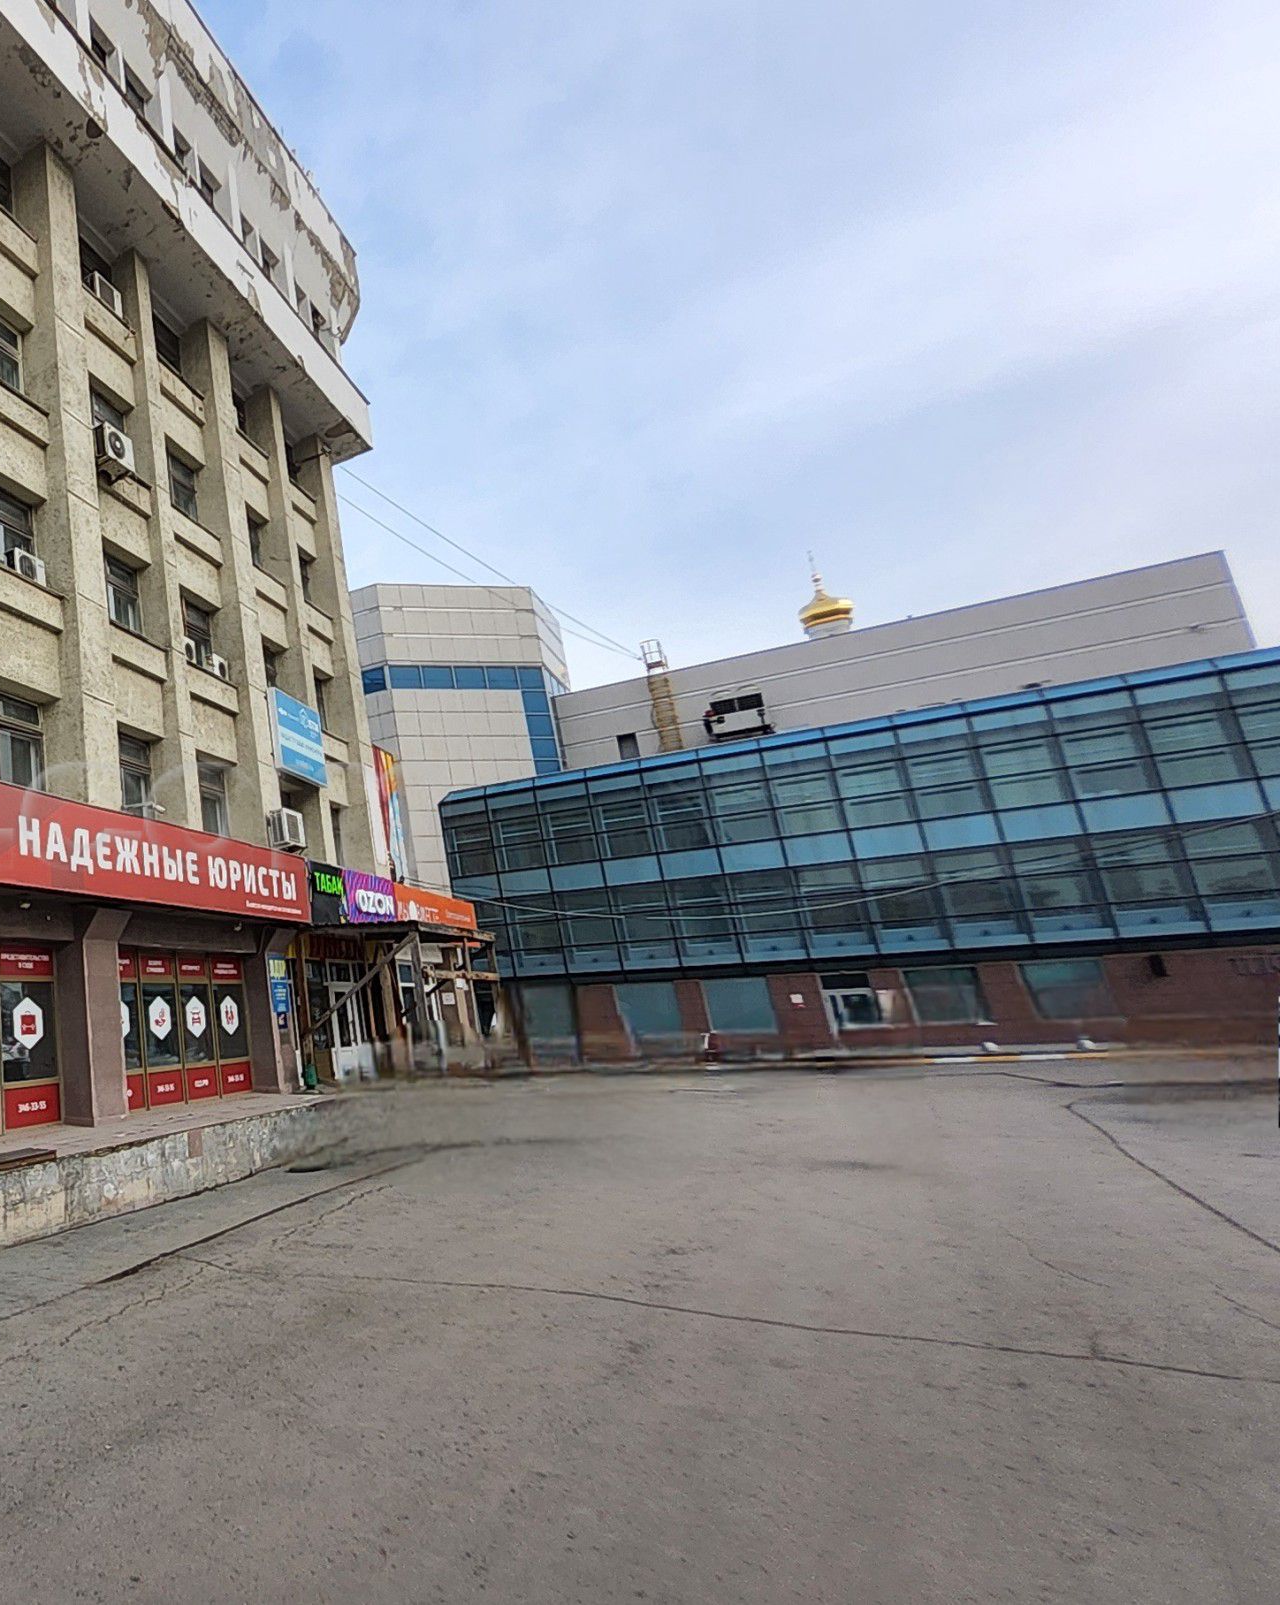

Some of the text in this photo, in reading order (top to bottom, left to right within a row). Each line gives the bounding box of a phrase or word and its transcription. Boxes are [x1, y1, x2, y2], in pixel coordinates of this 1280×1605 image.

[18, 815, 298, 901] НАДЕЖНЫЕ ЮРИСТЫ
[355, 888, 395, 916] OZON
